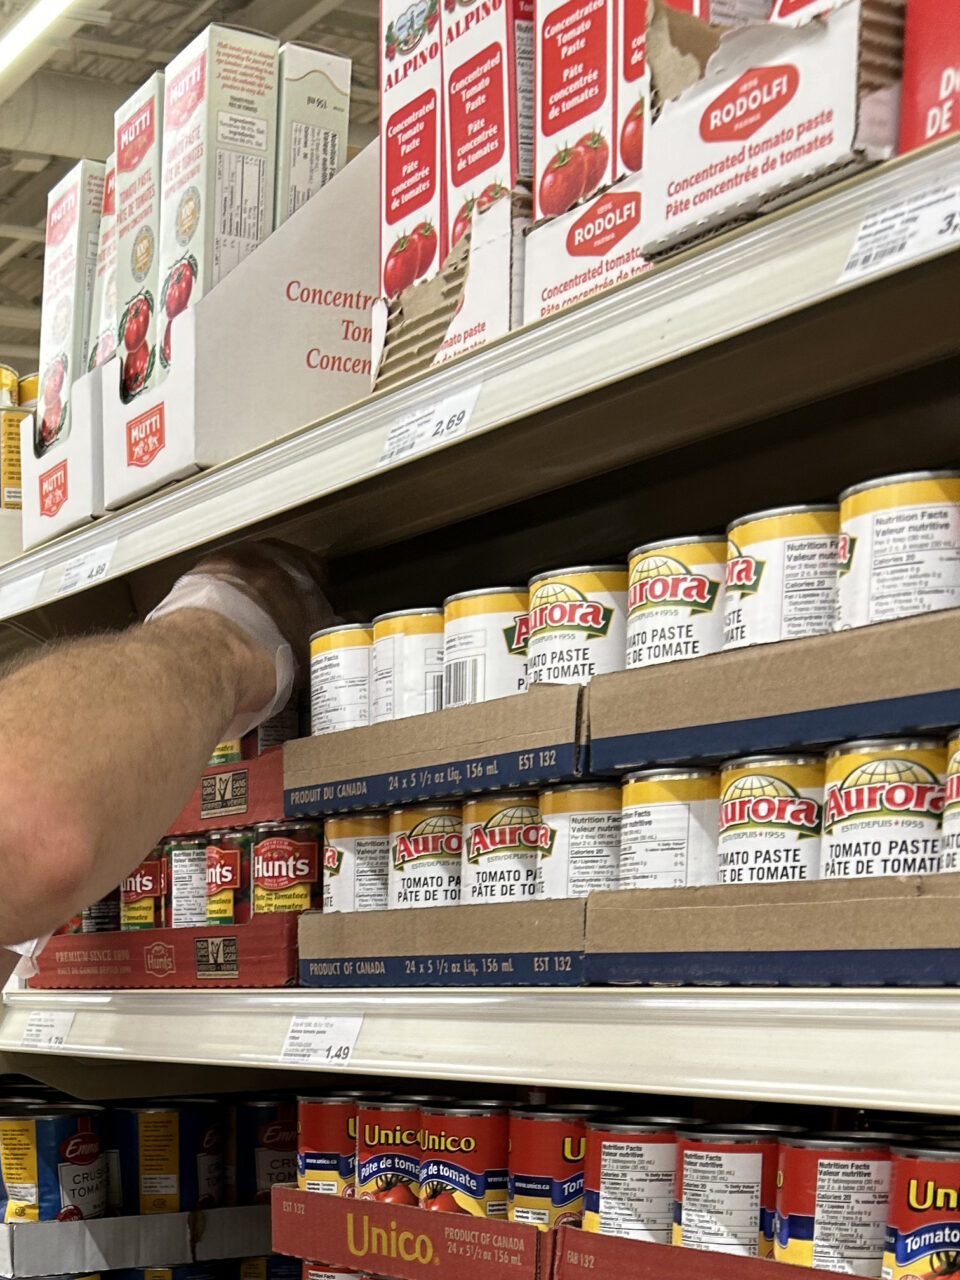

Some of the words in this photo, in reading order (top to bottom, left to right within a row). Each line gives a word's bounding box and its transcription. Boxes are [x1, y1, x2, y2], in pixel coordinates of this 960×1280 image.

[557, 20, 591, 46] Tomato
[561, 38, 585, 60] Paste
[384, 42, 438, 92] ALPINO
[461, 77, 489, 102] Tomato
[549, 69, 598, 105] concentrée
[465, 94, 486, 114] Paste
[548, 105, 561, 120] de
[563, 86, 598, 113] tomates
[710, 76, 788, 130] RODOLFI
[121, 110, 151, 151] MUTTI
[470, 140, 499, 166] tomates
[667, 144, 745, 198] Concentrated
[748, 130, 793, 160] tomato
[796, 108, 834, 140] paste
[692, 164, 758, 204] concentrée
[761, 156, 778, 176] de
[780, 132, 834, 166] tomates
[403, 180, 430, 203] tomates
[574, 202, 636, 245] RODOLFI
[541, 260, 603, 302] Concentrated
[131, 415, 160, 441] MUTTI
[432, 410, 465, 437] 2,69
[42, 472, 64, 494] MUTTI
[876, 513, 917, 526] Nutrition
[921, 510, 948, 520] Facts
[651, 624, 693, 642] PASTE
[550, 648, 590, 664] PASTE
[648, 641, 699, 658] TOMATE
[545, 664, 595, 680] TOMATE
[290, 787, 320, 805] PRODUIT
[323, 786, 335, 800] DU
[337, 782, 367, 797] CANADA
[389, 778, 399, 790] 24
[466, 763, 482, 779] 156
[518, 754, 534, 770] EST
[539, 750, 557, 766] 132
[571, 816, 605, 825] Nutrition
[901, 819, 924, 829] 1955
[754, 848, 800, 864] PASTE
[830, 841, 881, 857] TOMATO
[888, 839, 939, 855] PASTE
[476, 870, 522, 883] TOMATO
[749, 866, 807, 881] TOMATE
[856, 860, 874, 875] DE
[401, 876, 443, 888] TOMATO
[500, 885, 516, 896] DE
[424, 889, 439, 900] DE
[310, 963, 340, 976] PRODUCT
[344, 963, 353, 975] OF
[356, 961, 385, 974] CANADA
[406, 962, 416, 973] 24
[482, 959, 498, 971] 156
[534, 957, 550, 971] EST
[554, 957, 571, 970] 132
[65, 1137, 100, 1156] Emma
[603, 1143, 626, 1152] Nutrition
[628, 1144, 642, 1152] Facts
[380, 1157, 392, 1168] de
[819, 1161, 850, 1169] Nutrition
[853, 1163, 870, 1171] Facts
[439, 1166, 477, 1190] tomate
[841, 1170, 872, 1178] nutritive
[346, 1213, 433, 1264] Unico
[445, 1227, 478, 1245] PRODUCT
[481, 1234, 491, 1246] OF
[493, 1234, 524, 1251] CANADA
[448, 1242, 456, 1253] 24
[494, 1251, 508, 1264] 156
[567, 1250, 578, 1264] FAB
[579, 1255, 594, 1268] 132
